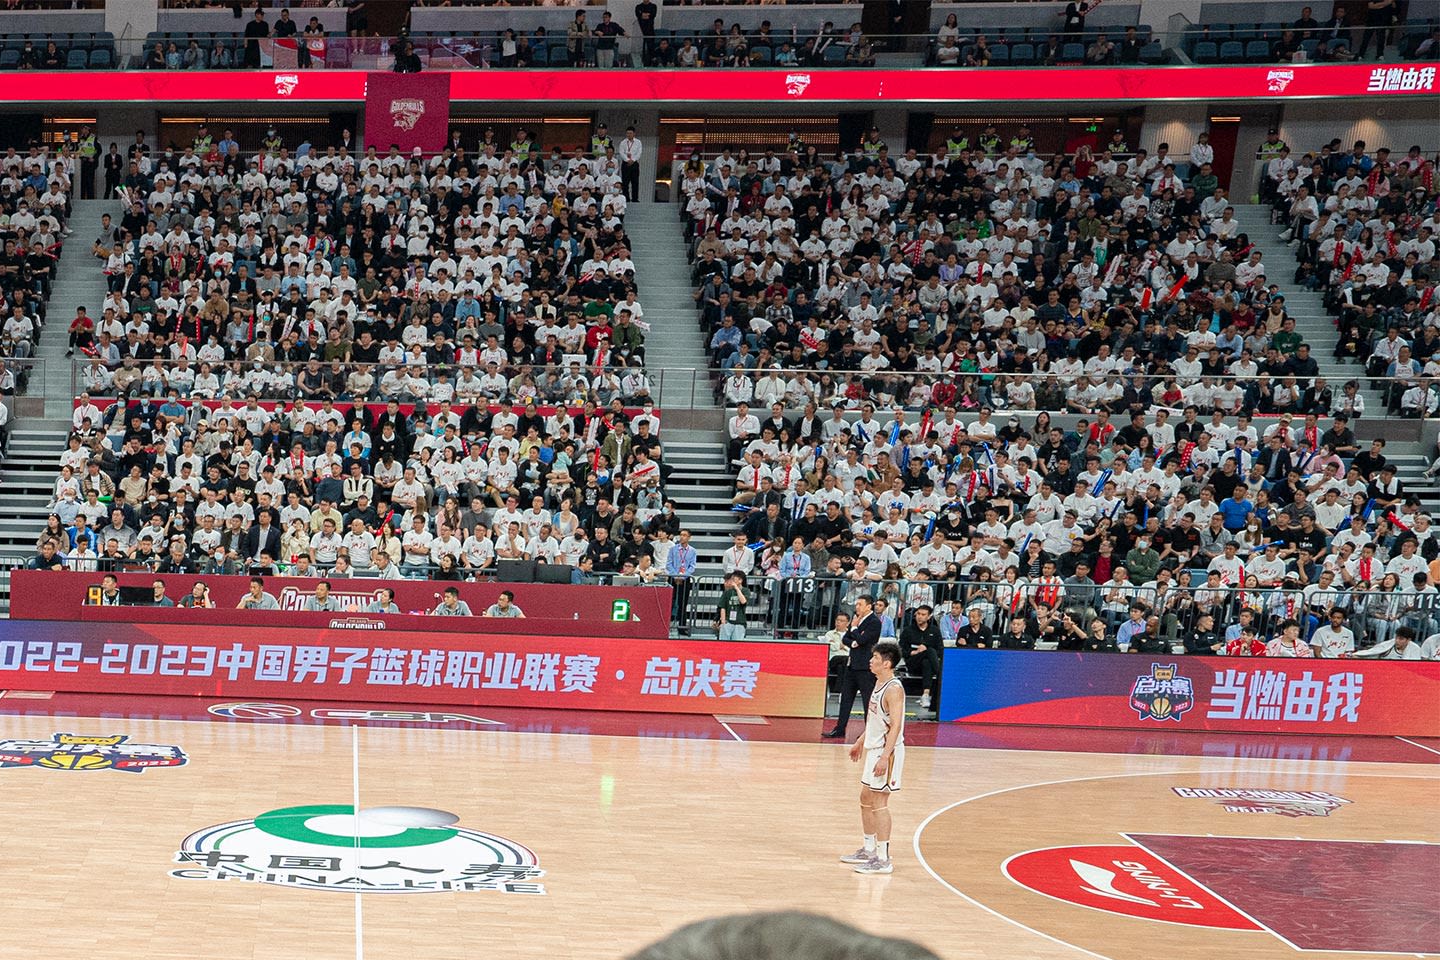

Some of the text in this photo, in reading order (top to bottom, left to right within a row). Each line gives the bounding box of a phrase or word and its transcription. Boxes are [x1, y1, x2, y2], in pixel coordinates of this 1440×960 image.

[1367, 67, 1437, 92] 当燃由我
[786, 579, 814, 592] 113
[613, 601, 629, 622] 2
[1135, 678, 1190, 695] 总决赛
[1207, 669, 1363, 722] 当燃由我
[179, 851, 544, 880] 中国人寿
[172, 869, 548, 894] CHINA LIFE
[1112, 860, 1204, 909] LI-NING
